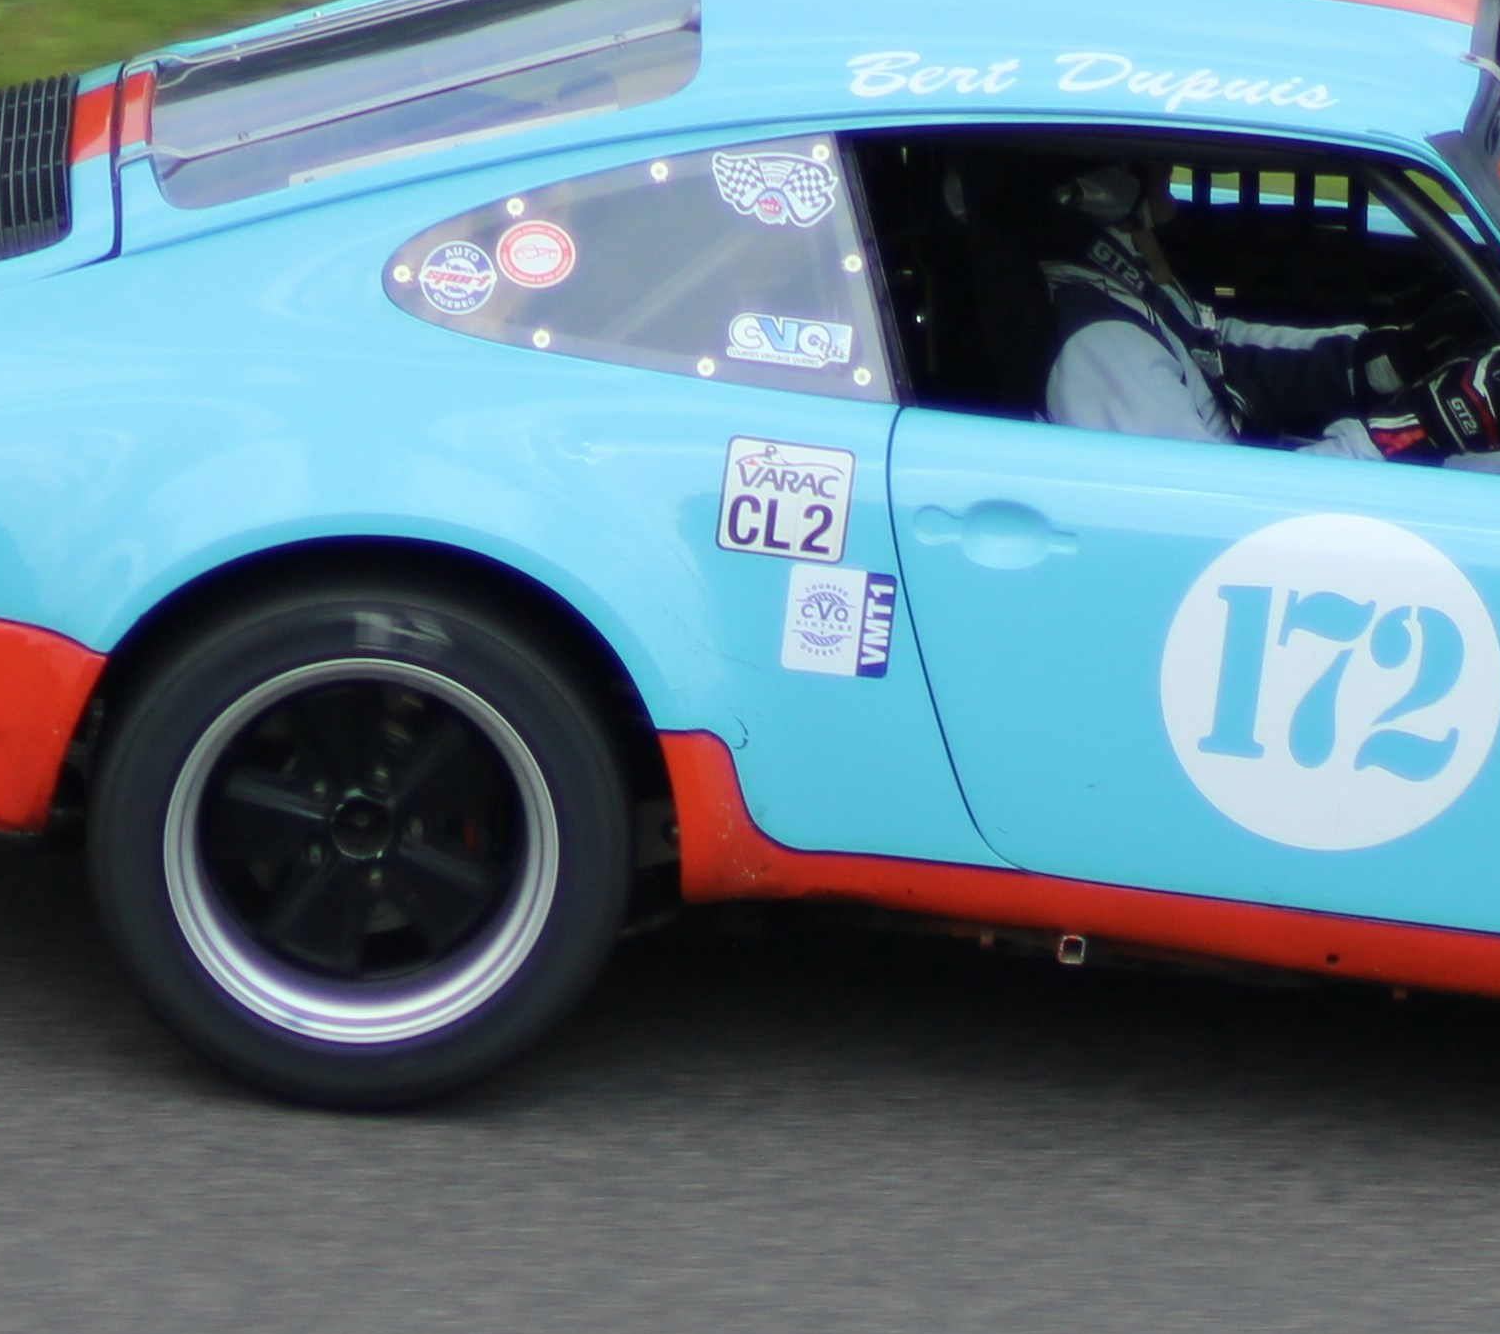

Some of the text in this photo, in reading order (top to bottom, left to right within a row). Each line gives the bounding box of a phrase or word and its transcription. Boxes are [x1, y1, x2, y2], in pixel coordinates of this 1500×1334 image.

[846, 51, 1339, 114] Bert Dupuis
[445, 246, 480, 263] AUTO
[425, 270, 492, 287] sport
[736, 461, 840, 500] VARAC
[801, 601, 849, 623] CVQ
[861, 583, 895, 665] VMT1
[1197, 584, 1465, 783] 172
